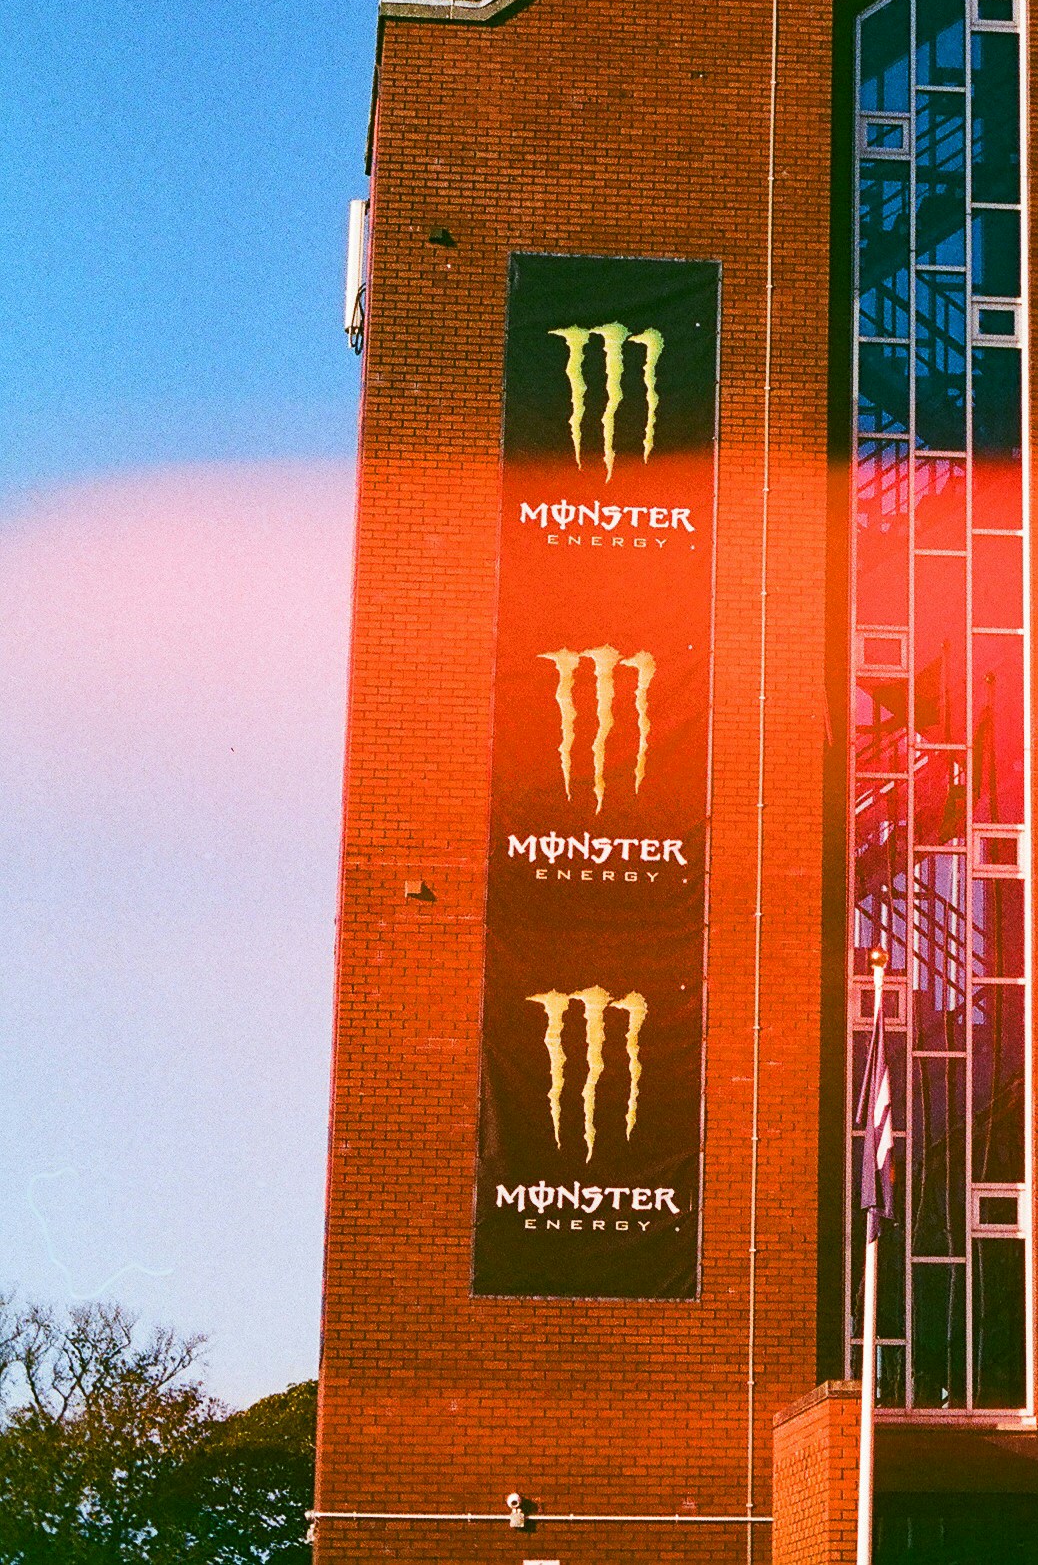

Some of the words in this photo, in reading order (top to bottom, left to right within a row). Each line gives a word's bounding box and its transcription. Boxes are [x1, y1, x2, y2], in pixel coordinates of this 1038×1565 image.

[520, 499, 694, 531] MONSTER
[547, 534, 667, 548] ENERGY
[507, 831, 687, 865] MONSTER
[535, 869, 659, 882] ENERGY
[496, 1181, 679, 1214] MONSTER
[525, 1219, 650, 1231] ENERGY
